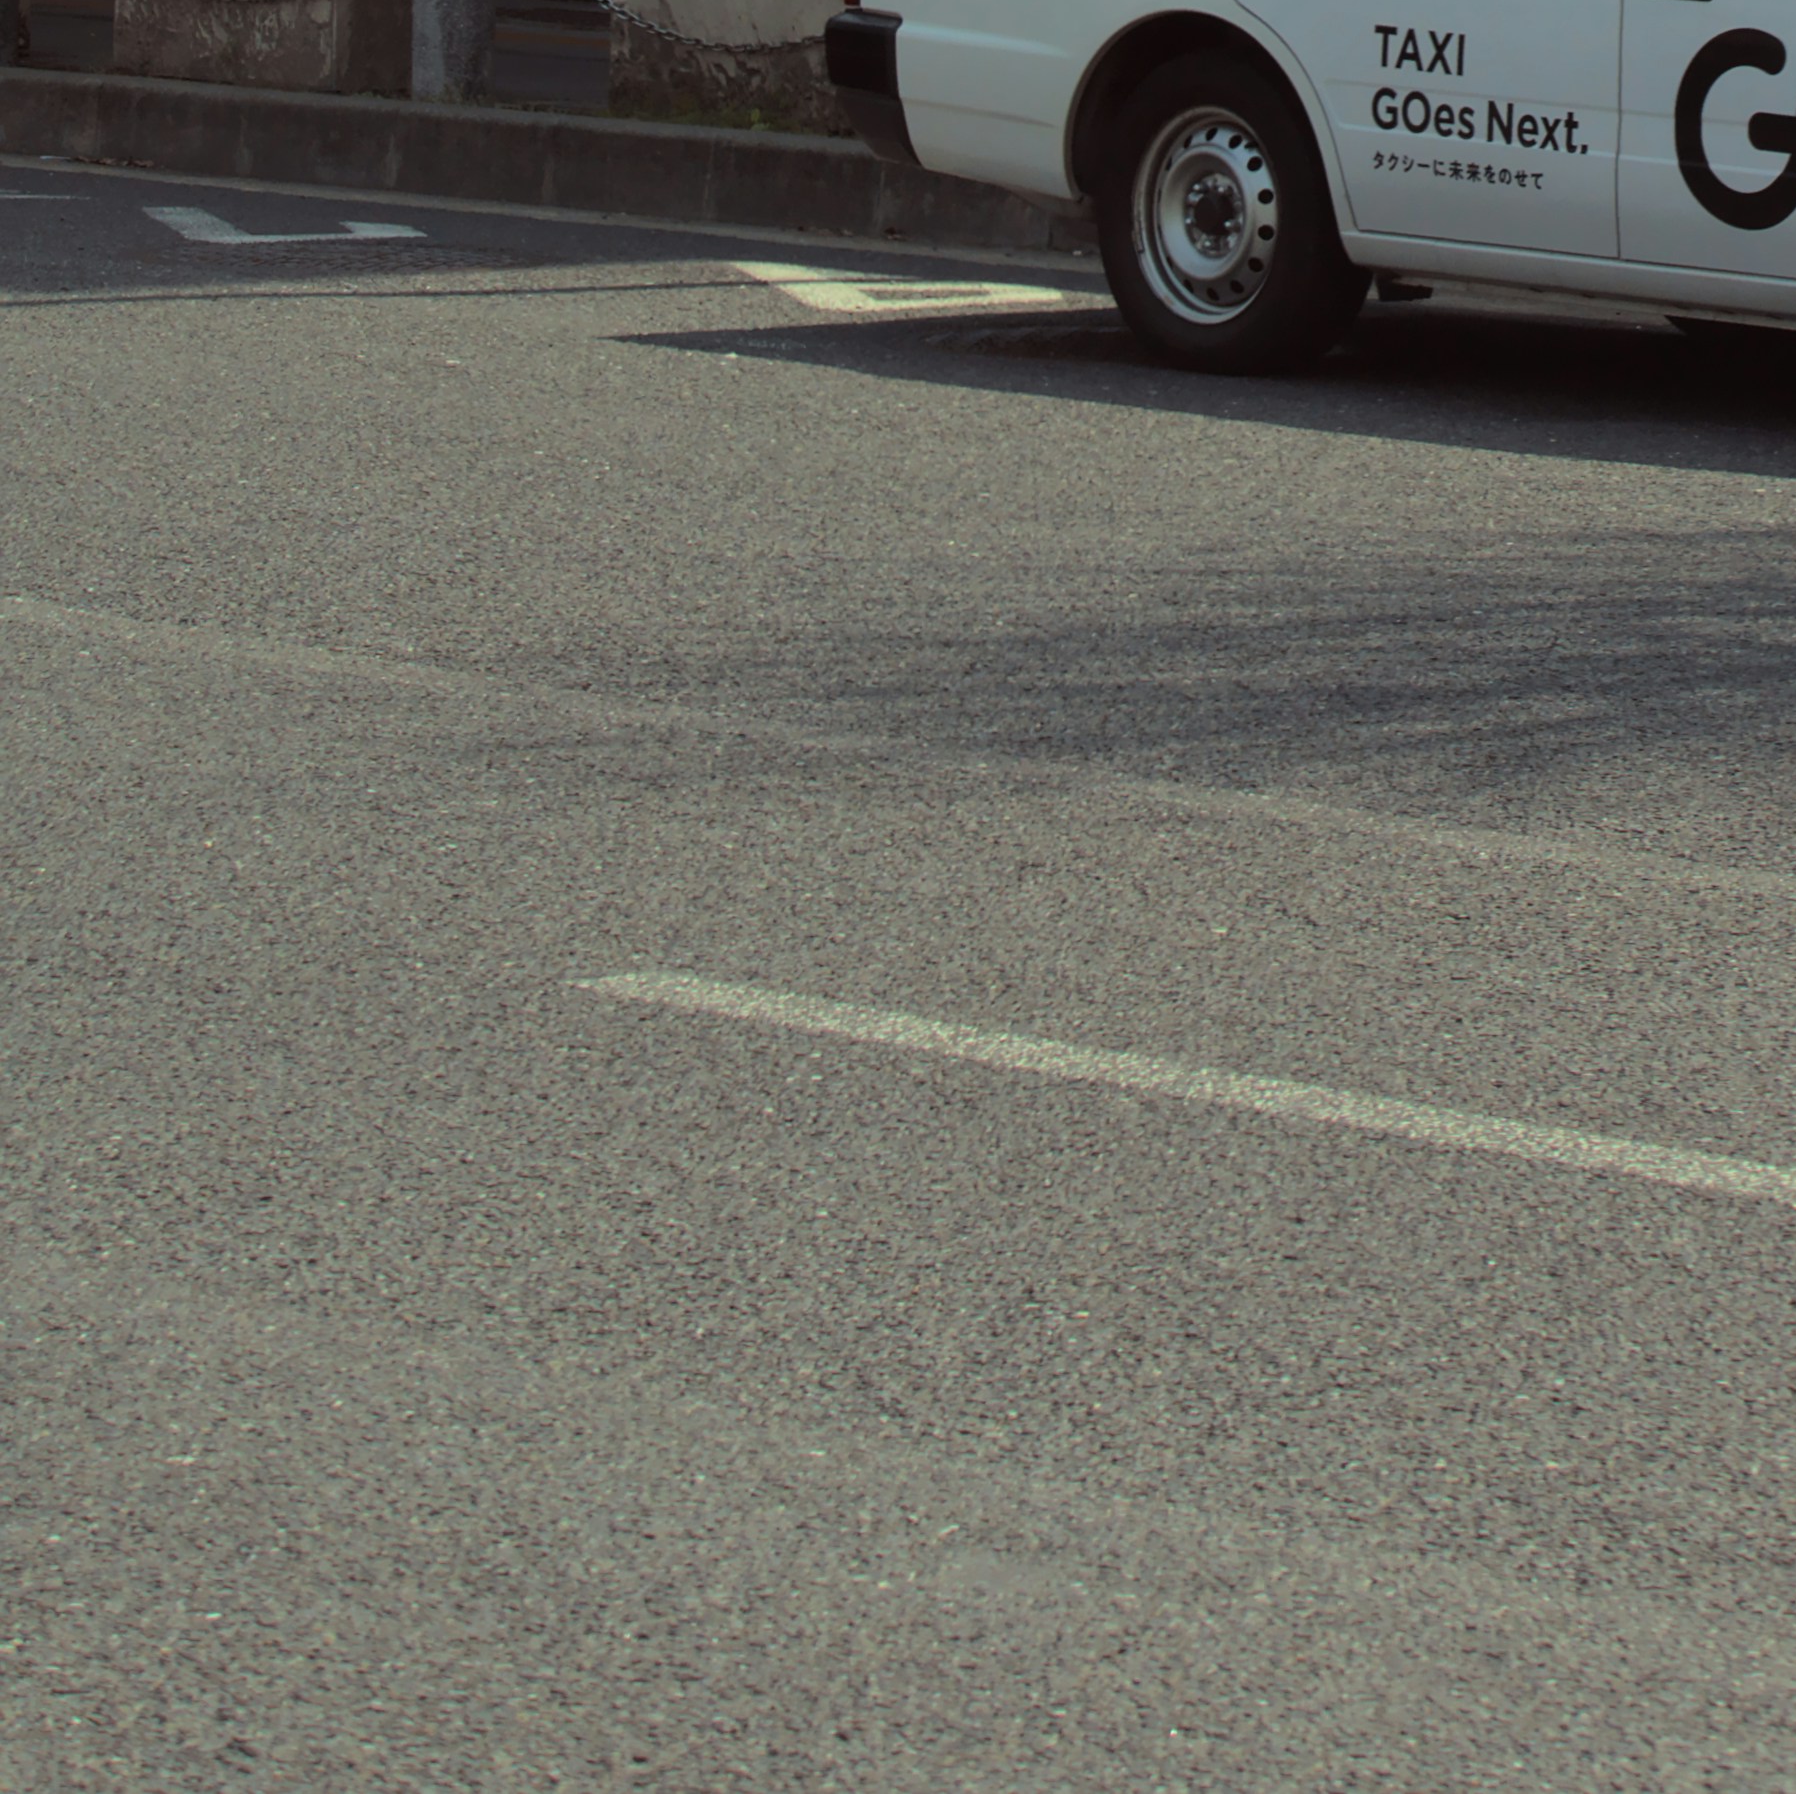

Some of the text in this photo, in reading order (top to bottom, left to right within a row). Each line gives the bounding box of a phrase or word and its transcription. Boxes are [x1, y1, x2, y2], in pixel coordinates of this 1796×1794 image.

[1374, 24, 1466, 77] TAXI
[1371, 87, 1589, 156] GOes Next.
[1372, 150, 1545, 190] タクシーに未来をのせて
